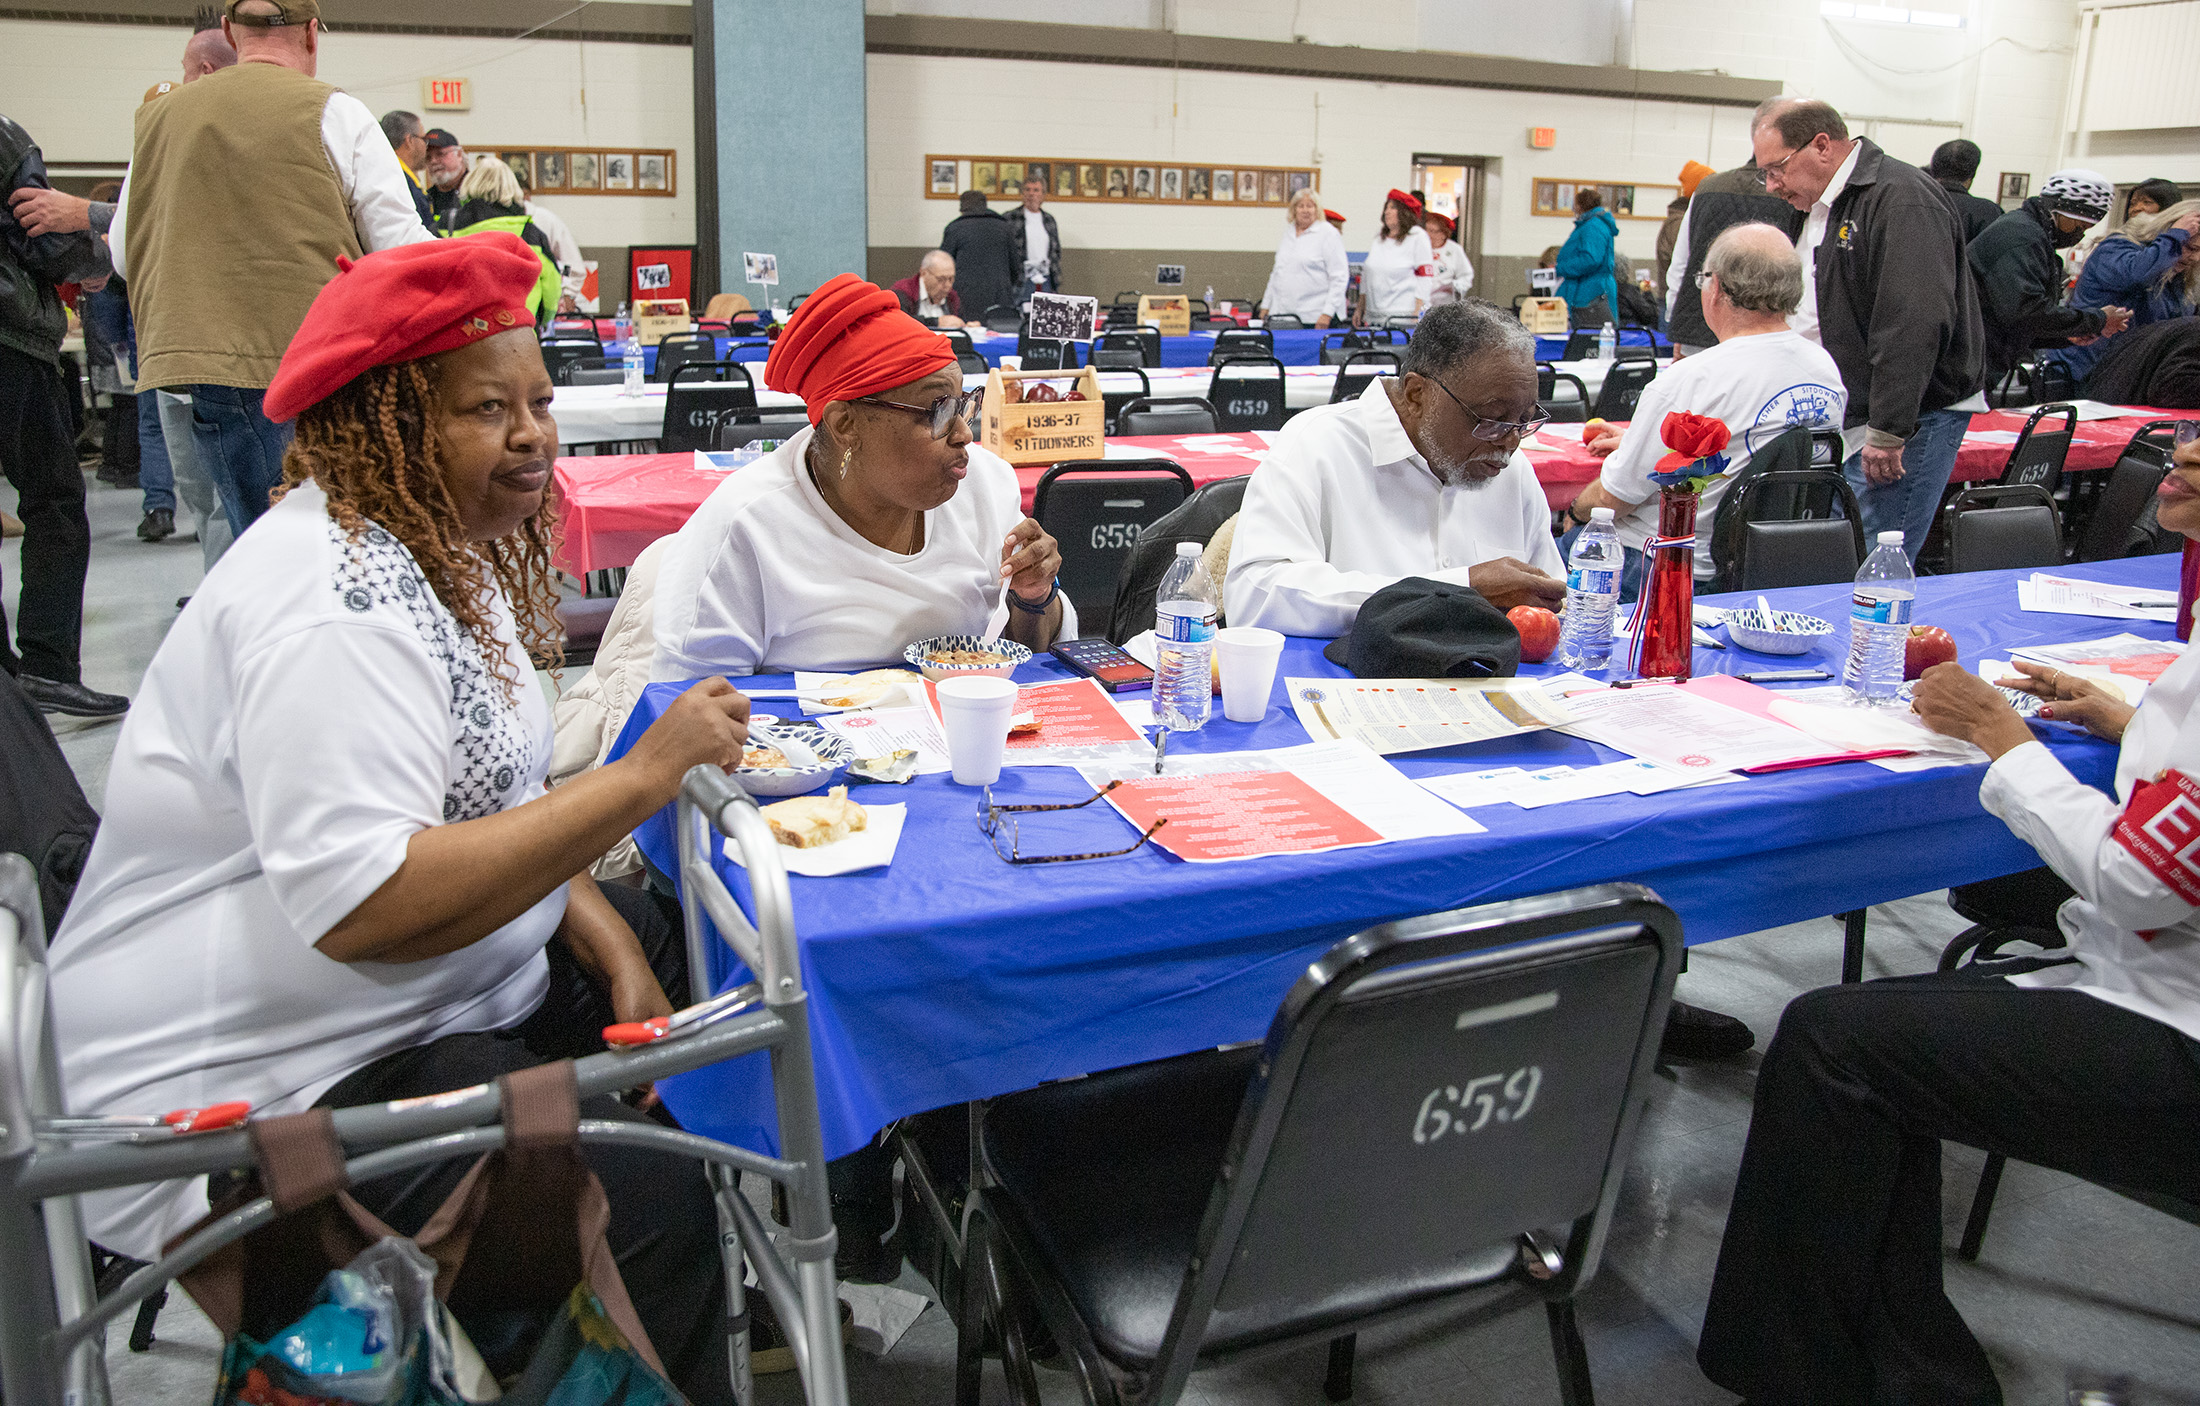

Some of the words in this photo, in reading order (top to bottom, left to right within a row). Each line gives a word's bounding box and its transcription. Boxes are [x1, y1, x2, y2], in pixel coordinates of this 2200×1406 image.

[432, 80, 463, 104] EXIT
[1228, 399, 1269, 415] 659
[1026, 413, 1081, 429] 1936-37
[1014, 434, 1095, 452] SITDOWNERS
[2019, 462, 2049, 484] 659
[1091, 523, 1142, 549] 659
[2177, 777, 2200, 799] UAW
[2118, 821, 2166, 866] Emergency
[1413, 1065, 1543, 1145] 659
